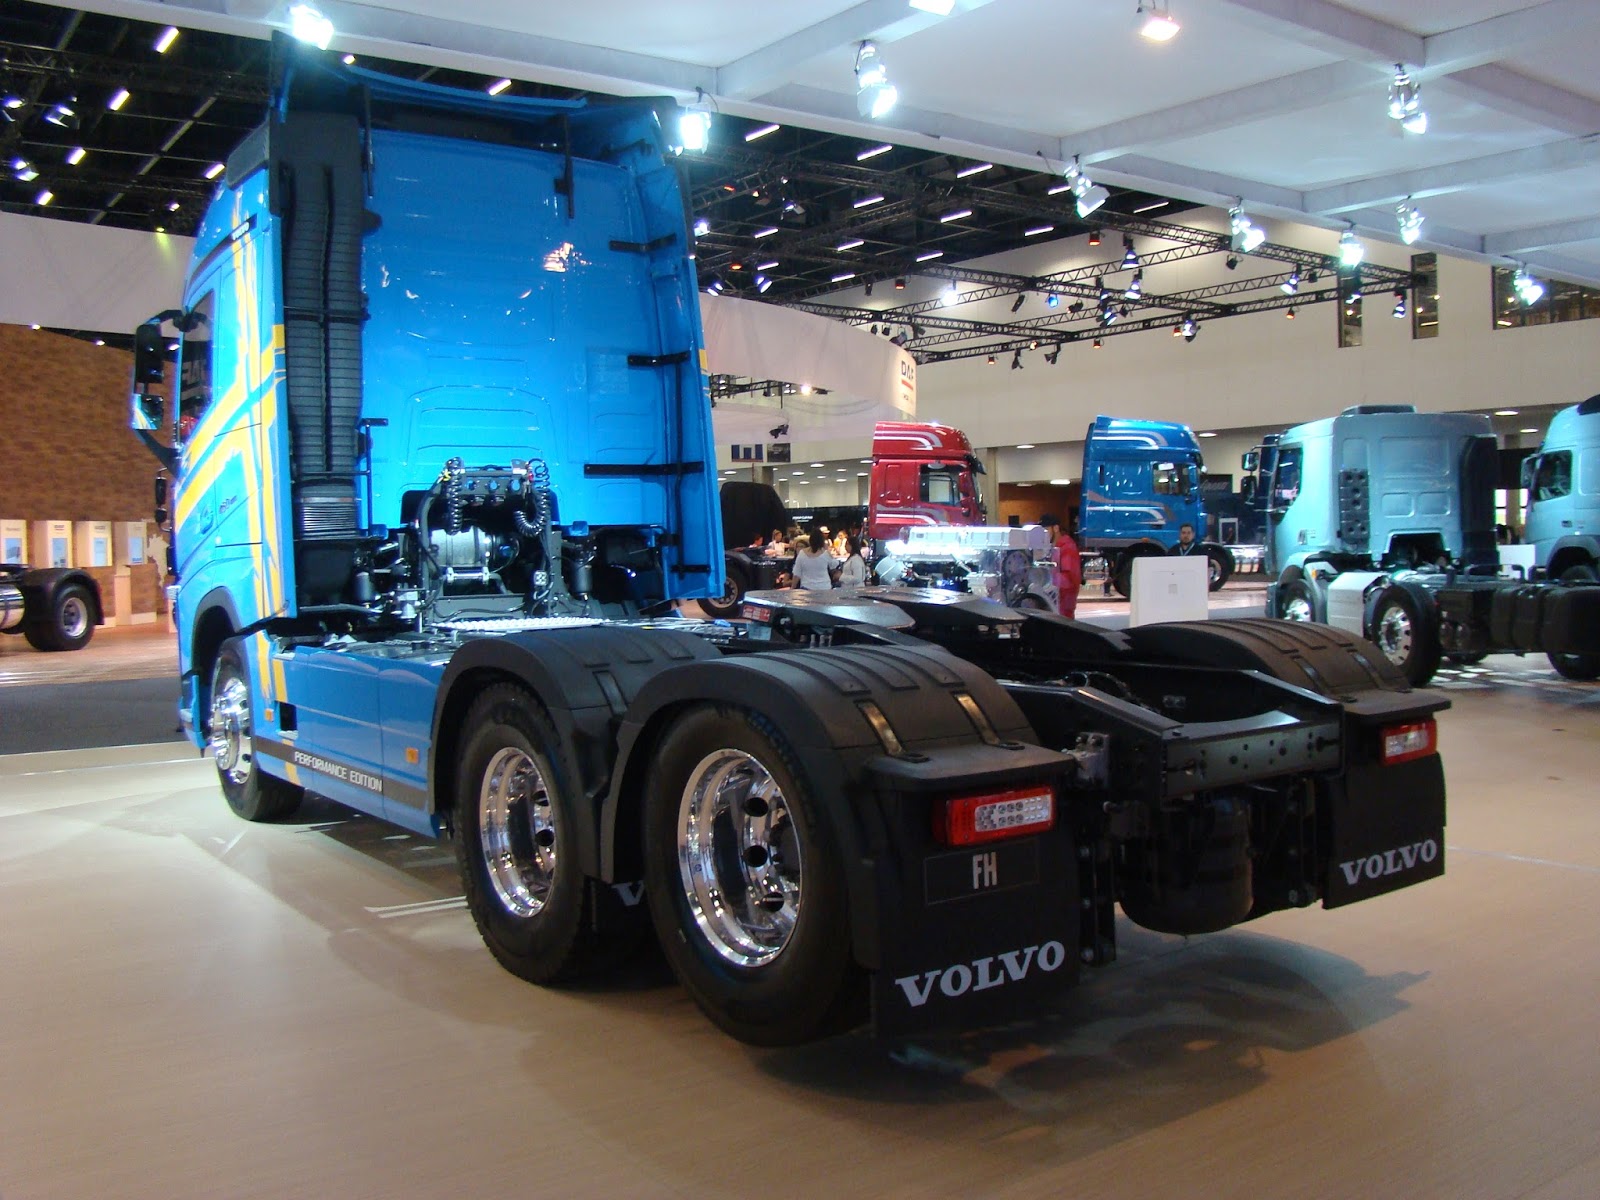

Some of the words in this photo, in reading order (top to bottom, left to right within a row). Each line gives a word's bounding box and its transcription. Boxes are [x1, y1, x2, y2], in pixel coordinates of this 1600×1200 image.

[294, 751, 348, 780] PERFORMANCE
[349, 770, 383, 792] EDITION
[972, 851, 998, 890] FH
[1339, 838, 1438, 886] VOLVO
[895, 940, 1066, 1008] VOLVO
